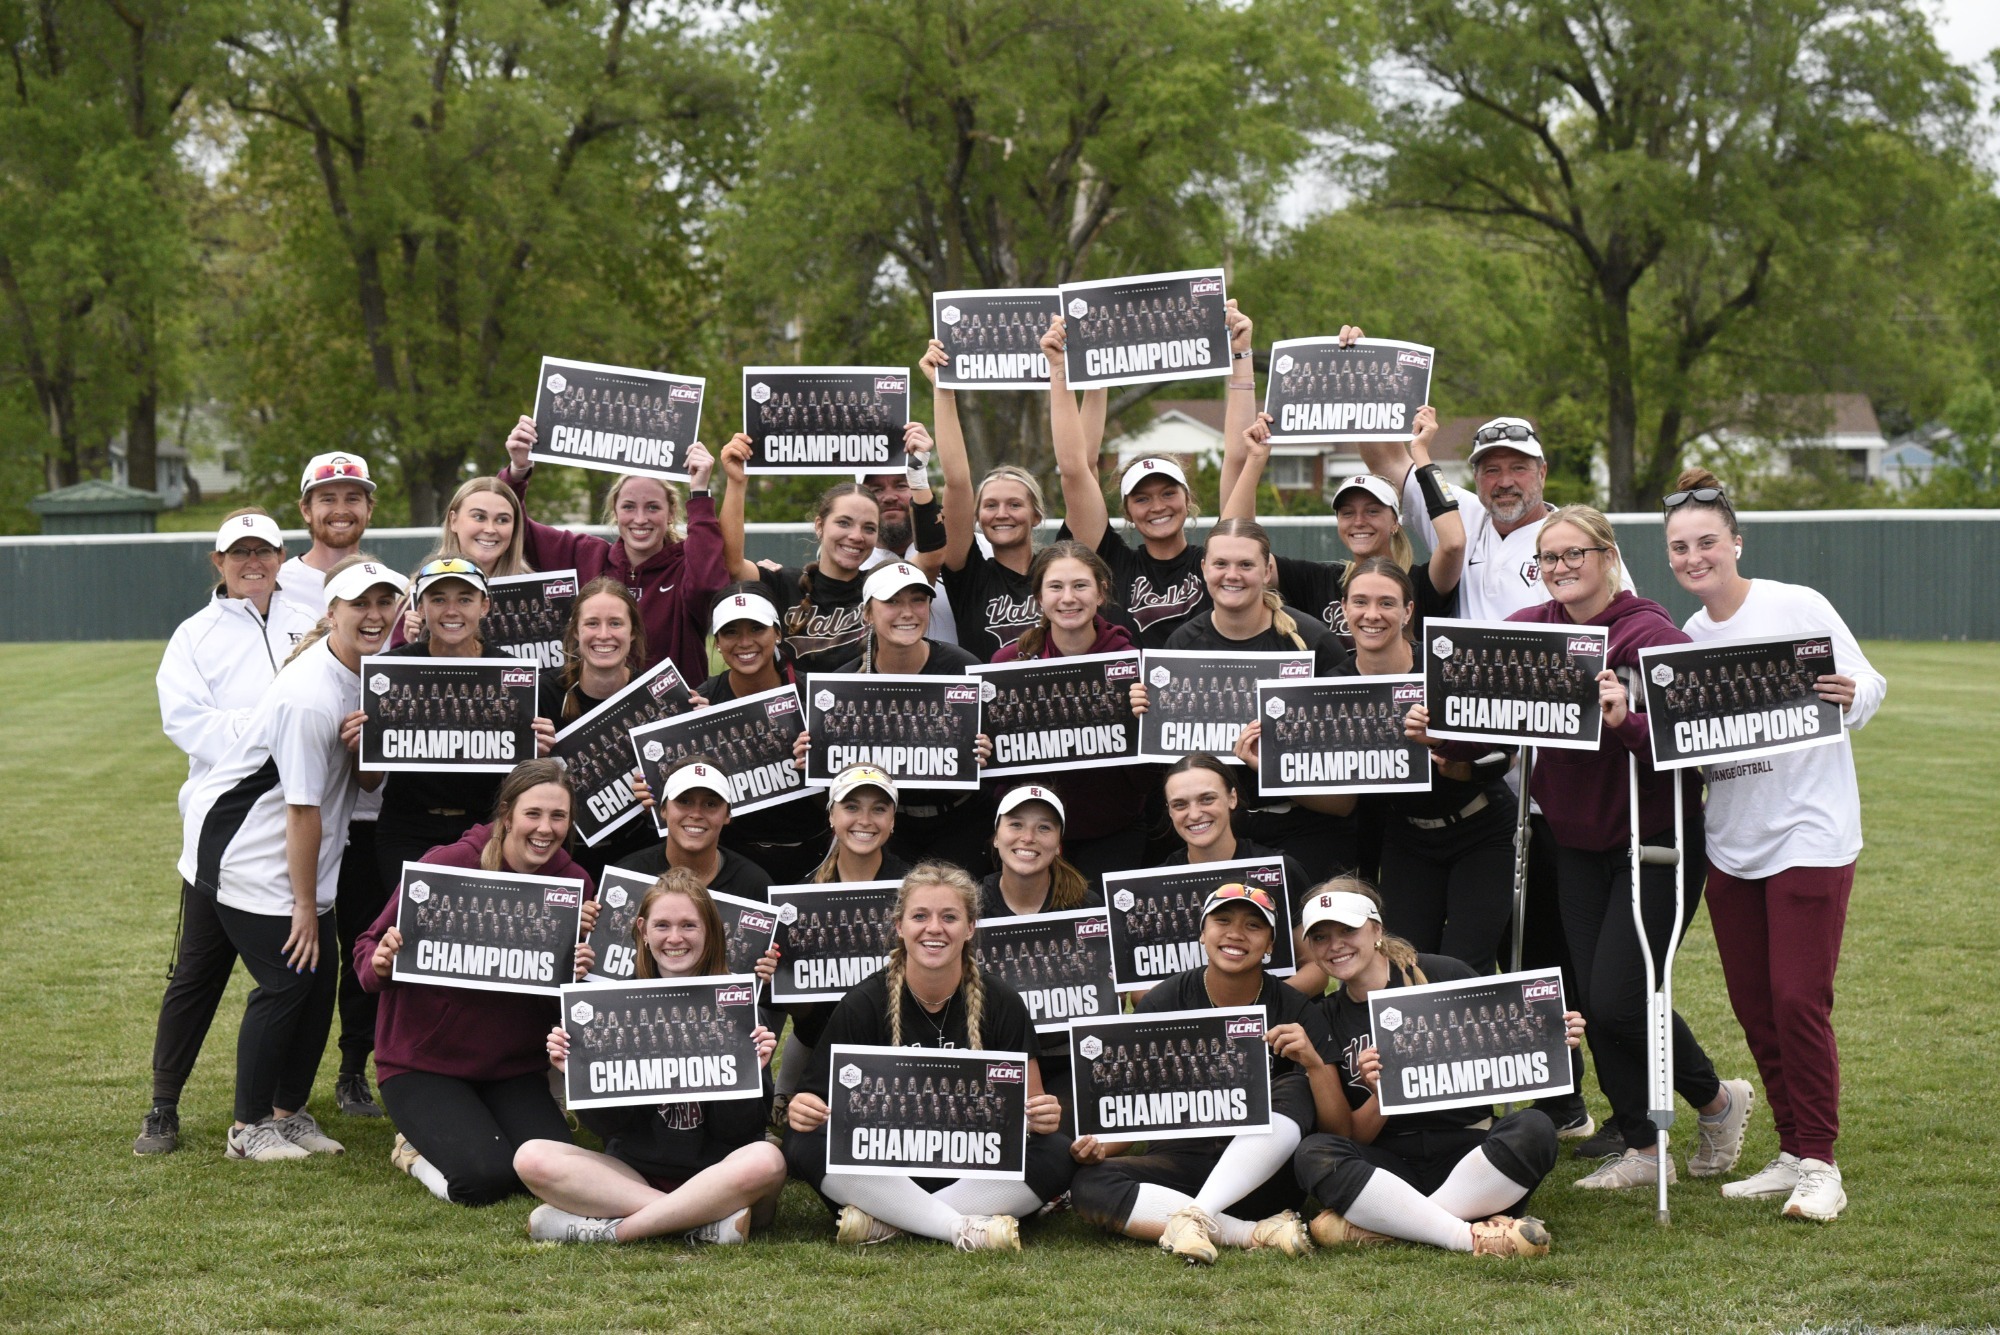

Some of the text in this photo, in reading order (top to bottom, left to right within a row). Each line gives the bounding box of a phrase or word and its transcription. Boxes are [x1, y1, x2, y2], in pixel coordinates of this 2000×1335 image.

[1192, 282, 1220, 293] KCAC
[1085, 337, 1210, 376] CHAMPIONS
[1398, 354, 1428, 366] KCAC
[956, 353, 1050, 379] CHAMPIO
[876, 380, 904, 389] KCAC
[670, 388, 698, 401] KCAC
[1280, 402, 1405, 430] CHAMPIONS
[550, 425, 674, 467] CHAMPIONS
[764, 434, 888, 462] CHAMPIONS
[545, 584, 572, 594] KCAC
[1569, 637, 1602, 653] KCAC
[1796, 642, 1831, 658] KCAC
[503, 672, 532, 682] KCAC
[1107, 665, 1136, 676] KCAC
[1280, 664, 1310, 676] KCAC
[650, 672, 676, 695] KCAC
[946, 689, 976, 699] KCAC
[1394, 689, 1423, 699] KCAC
[768, 698, 795, 714] KCAC
[1445, 695, 1580, 734] CHAMPIONS
[1673, 704, 1821, 752] CHAMPIONS
[382, 728, 515, 759] CHAMPIONS
[994, 723, 1126, 762] CHAMPIONS
[1161, 722, 1246, 751] CHAMP
[1280, 748, 1409, 782] CHAMPIONS
[1736, 760, 1774, 776] OFTBALL
[728, 758, 800, 804] PIONS
[545, 891, 577, 904] KCAC
[740, 913, 772, 929] KCAC
[1077, 922, 1107, 934] KCAC
[416, 939, 554, 982] CHAMPIONS
[794, 956, 890, 989] CHAMP
[718, 991, 750, 1002] KCAC
[1525, 984, 1557, 998] KCAC
[1018, 984, 1099, 1020] PIONS
[1228, 1022, 1260, 1034] KCAC
[589, 1054, 736, 1092] CHAMPIONS
[988, 1067, 1021, 1078] KCAC
[1401, 1050, 1549, 1099] CHAMPIONS
[1098, 1087, 1247, 1128] CHAMPIONS
[851, 1127, 1000, 1164] CHAMPIONS
